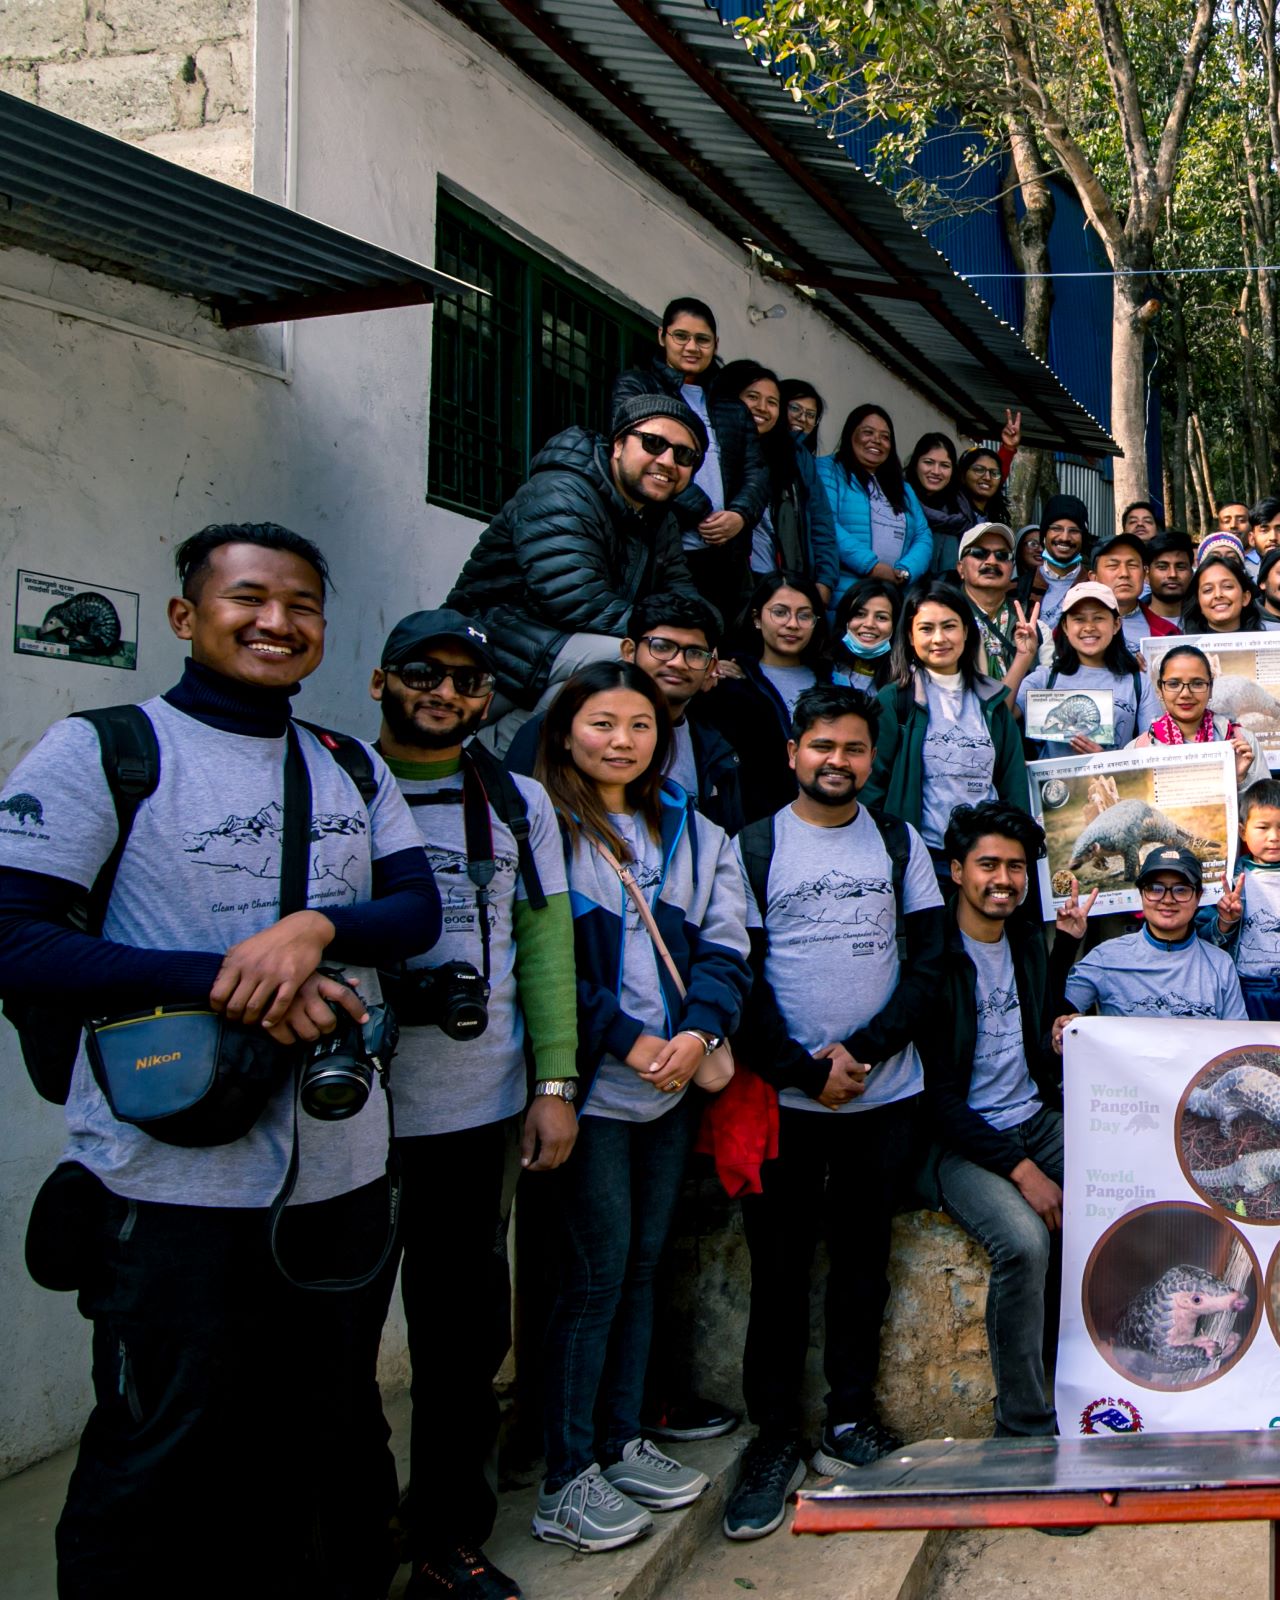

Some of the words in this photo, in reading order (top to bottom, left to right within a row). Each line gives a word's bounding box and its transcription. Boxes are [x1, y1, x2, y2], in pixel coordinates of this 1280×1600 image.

[211, 902, 235, 914] Clean
[238, 903, 249, 915] up
[135, 1051, 182, 1071] Nikon
